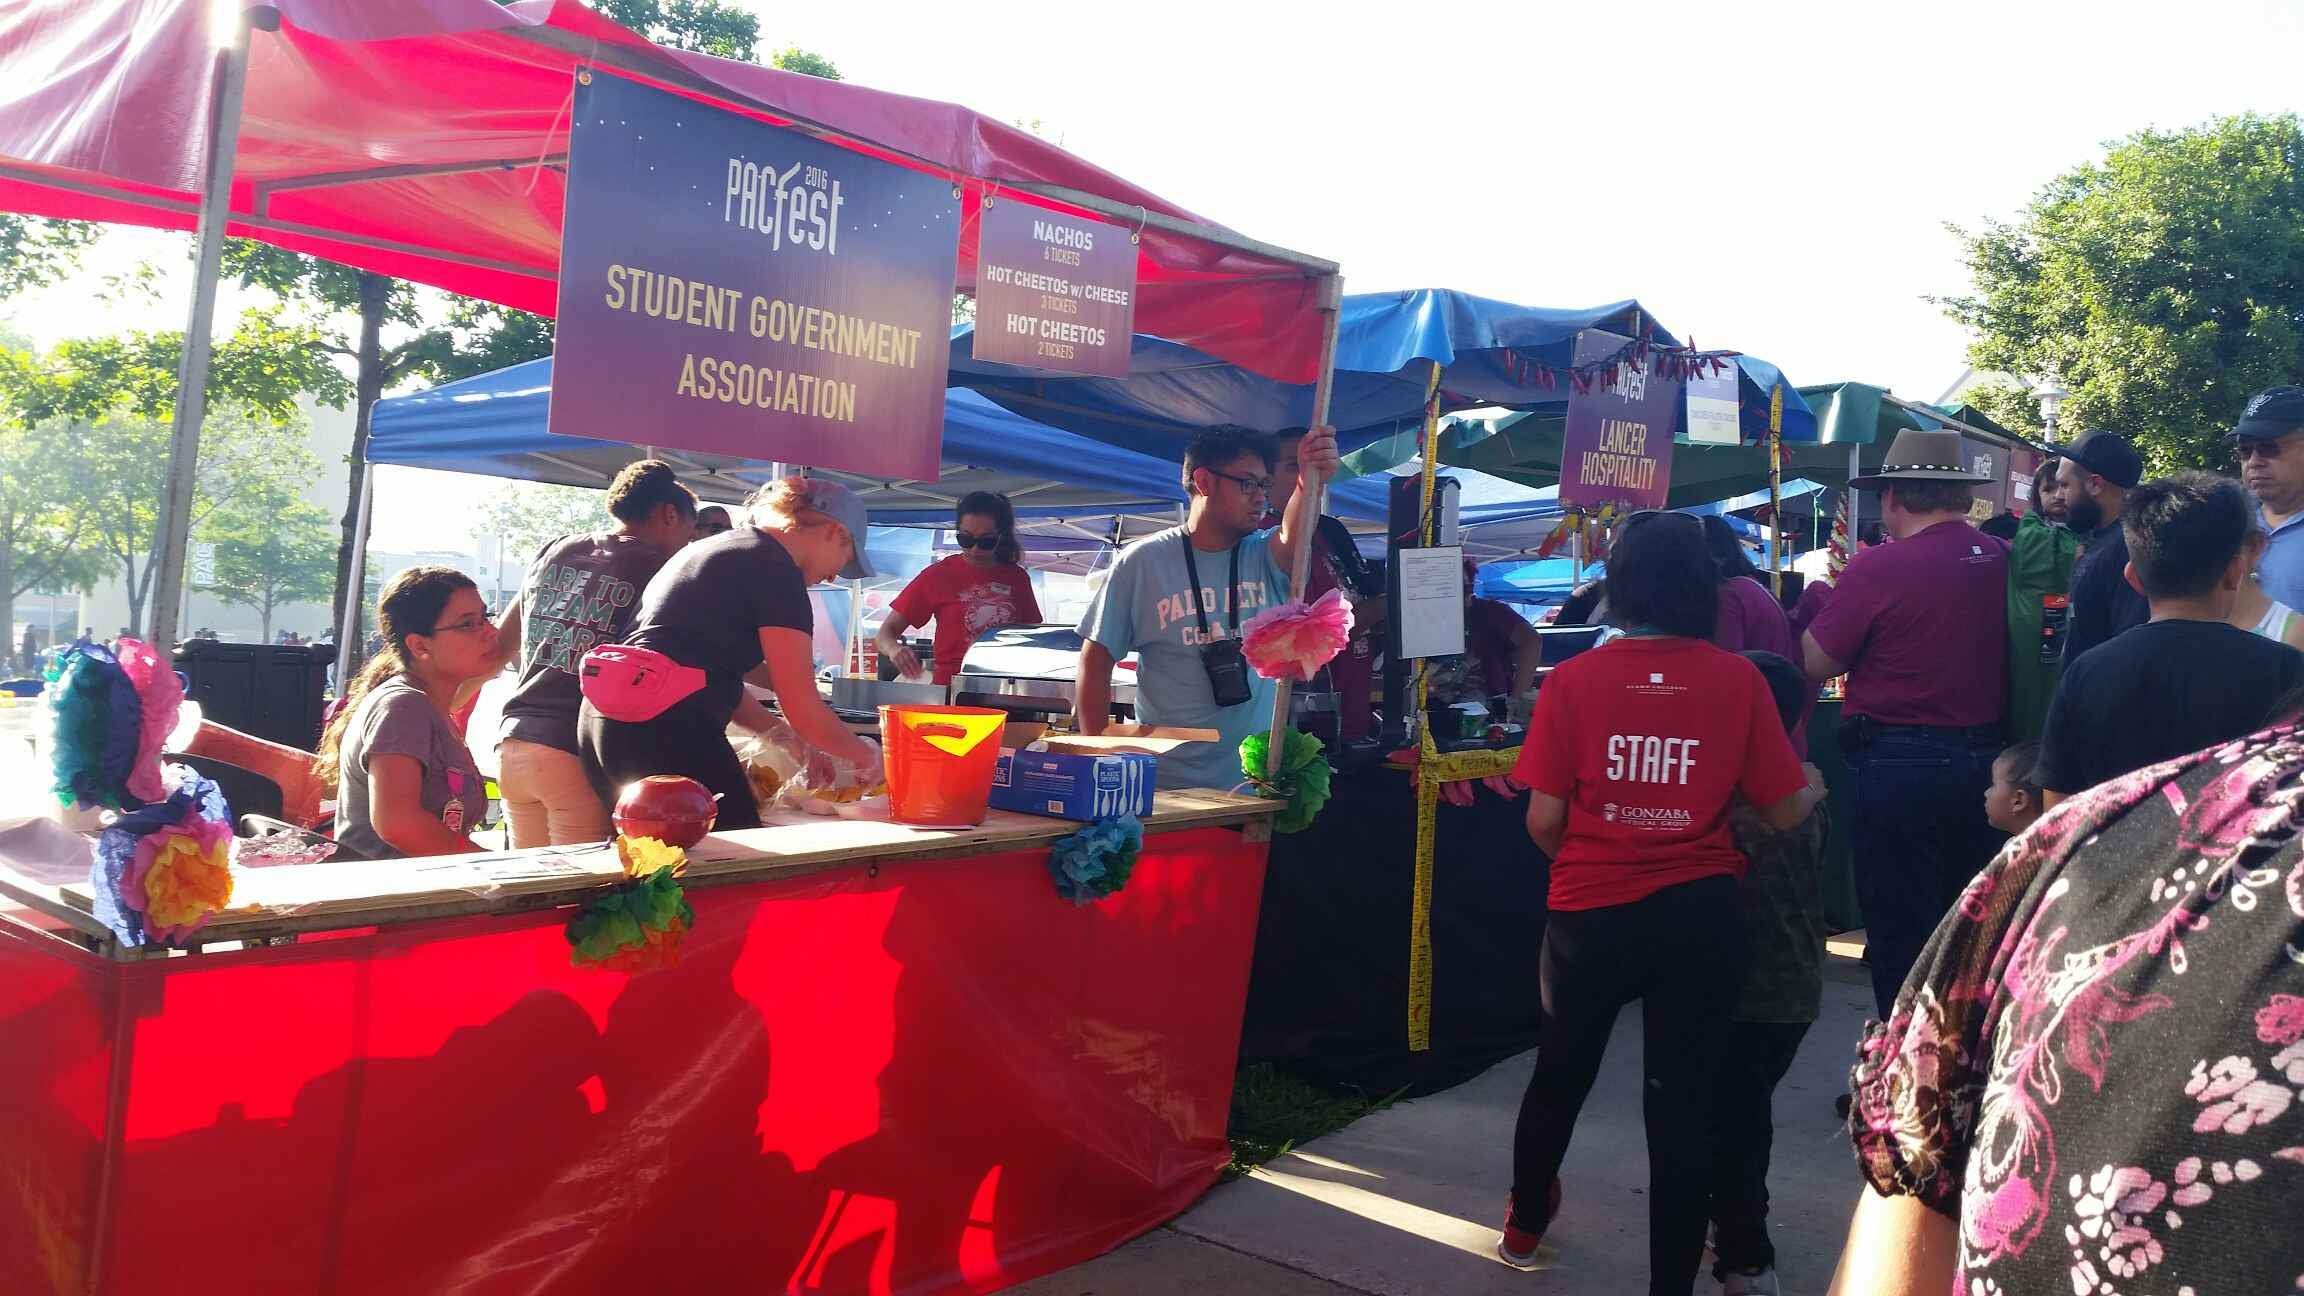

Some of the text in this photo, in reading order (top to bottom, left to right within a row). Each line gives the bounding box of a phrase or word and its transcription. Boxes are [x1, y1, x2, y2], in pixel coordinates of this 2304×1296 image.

[805, 165, 828, 190] 2016
[1033, 220, 1093, 251] NACHOS
[1051, 247, 1081, 267] TICKETS
[987, 264, 1129, 306] HOT CHEETOS w/ CHEESE
[1048, 295, 1078, 314] TICKETS
[605, 263, 921, 369] STUDENT GOVERNMENT
[1007, 313, 1106, 347] HOT CHEETOS
[1045, 342, 1074, 360] TICKETS
[676, 353, 857, 423] ASSOCIATION
[1599, 418, 1648, 456] LANCER
[1579, 451, 1657, 491] HOSPITALITY
[543, 562, 635, 608] ARE TO
[533, 587, 615, 631] REAM
[1157, 581, 1266, 630] PALO LT
[1606, 734, 1700, 785] STAFF
[1621, 806, 1691, 820] GONZABA
